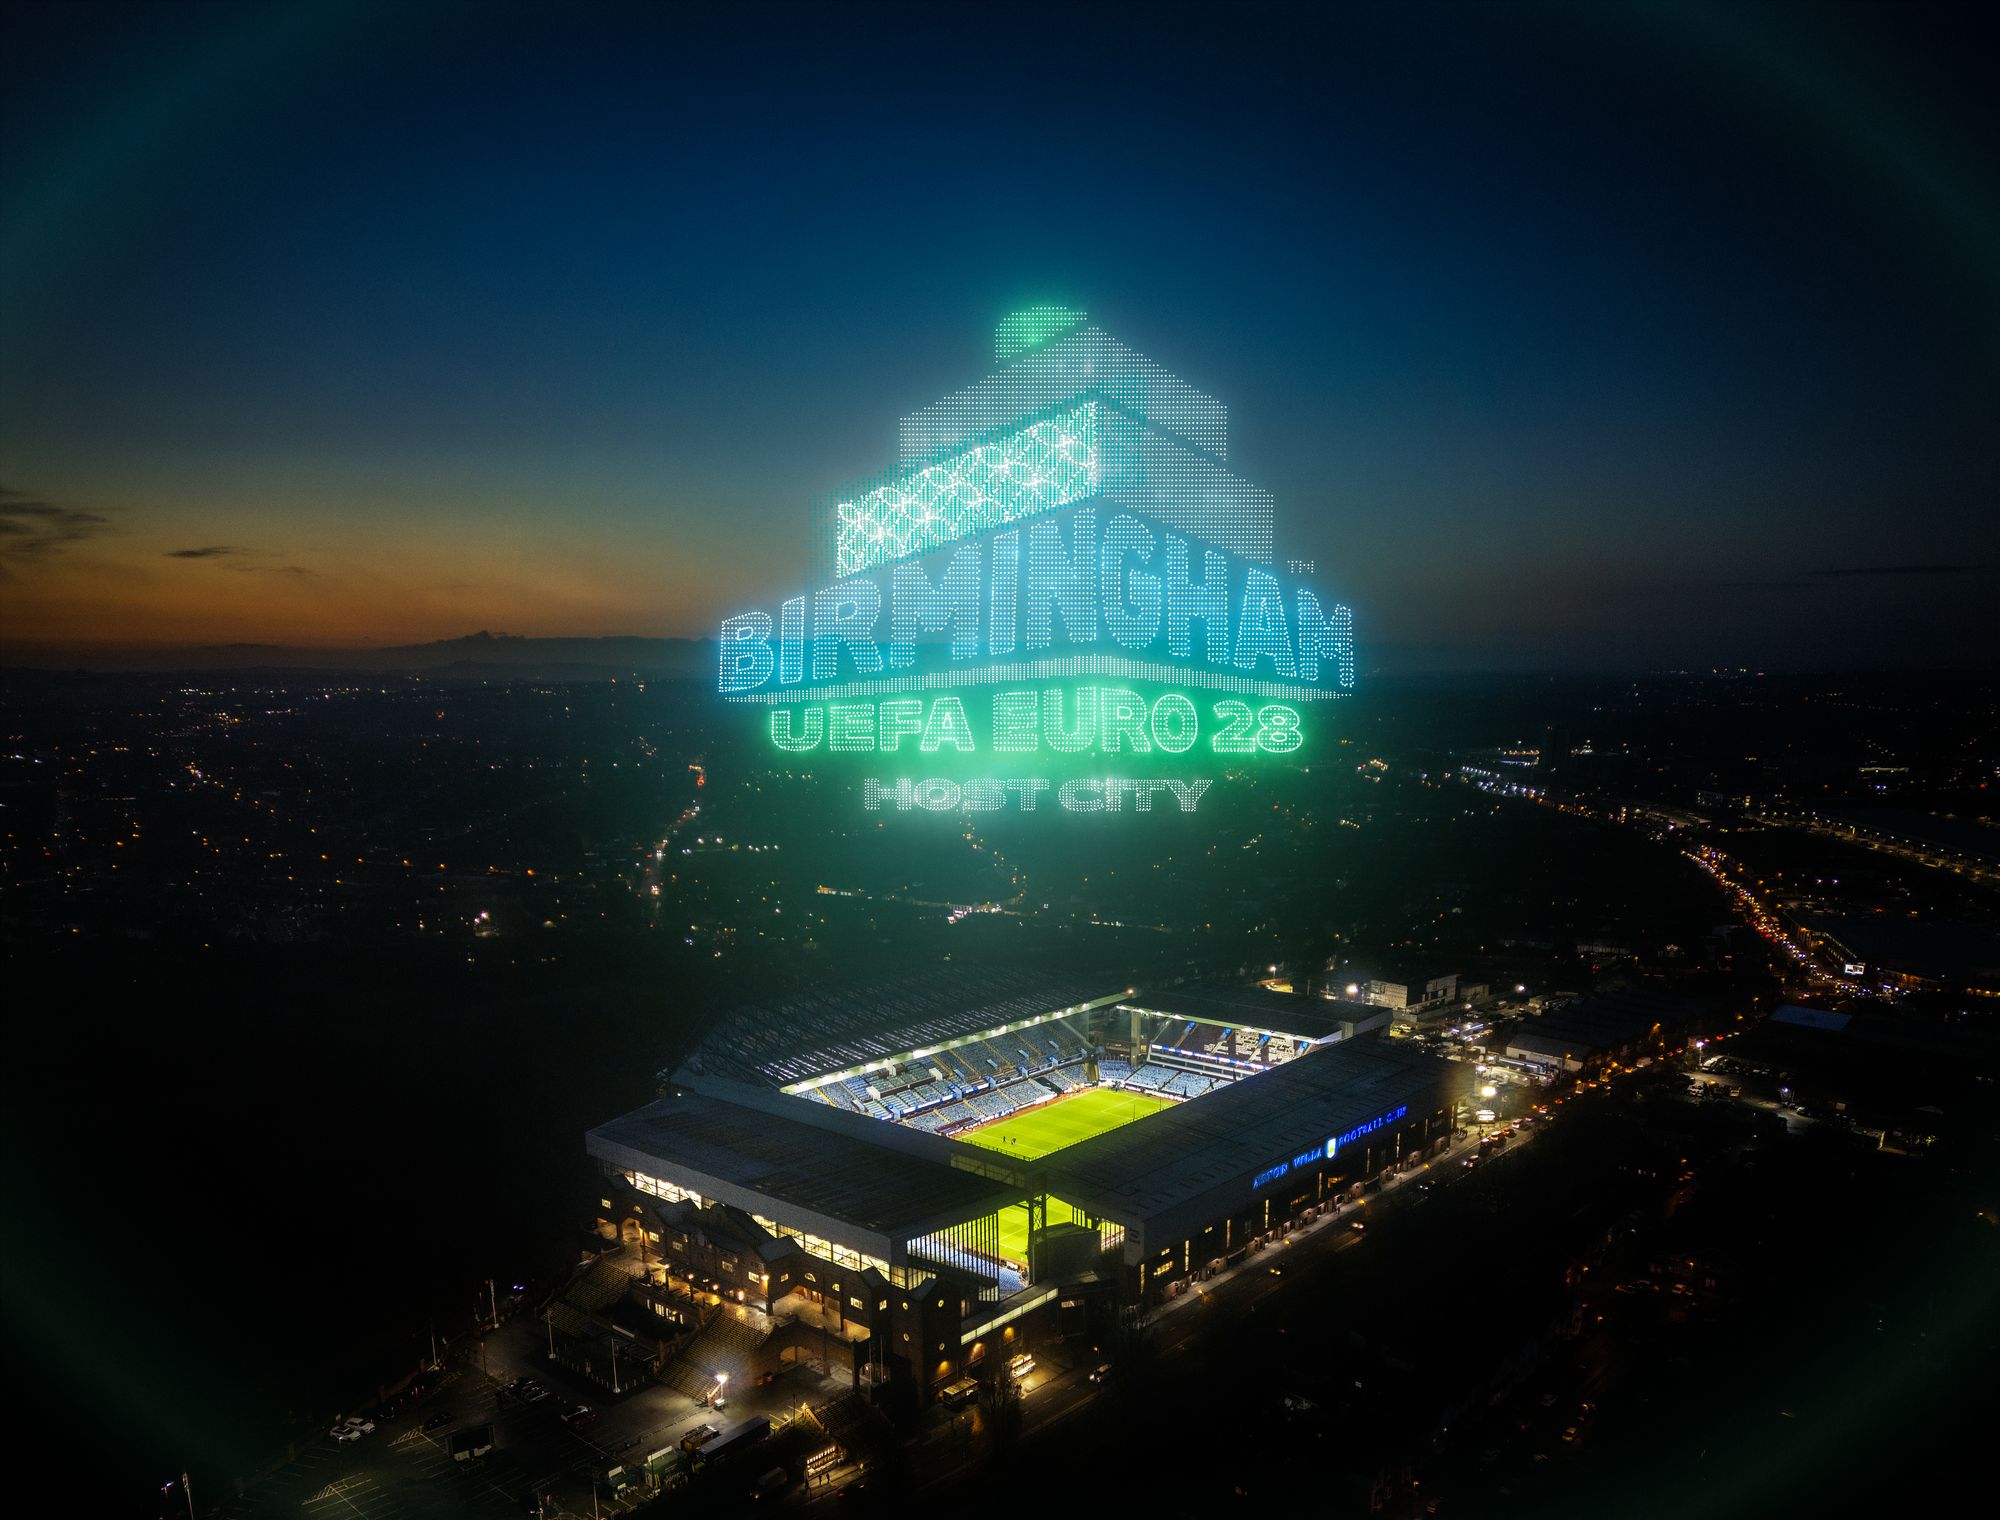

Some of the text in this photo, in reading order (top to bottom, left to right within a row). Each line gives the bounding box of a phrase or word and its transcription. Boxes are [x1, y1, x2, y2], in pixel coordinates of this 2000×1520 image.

[718, 507, 1354, 693] BIRMINGHAM
[771, 685, 1303, 753] UEFA EURO 28
[864, 777, 1214, 812] HOST CITY
[1337, 1117, 1384, 1148] FOOTBALL
